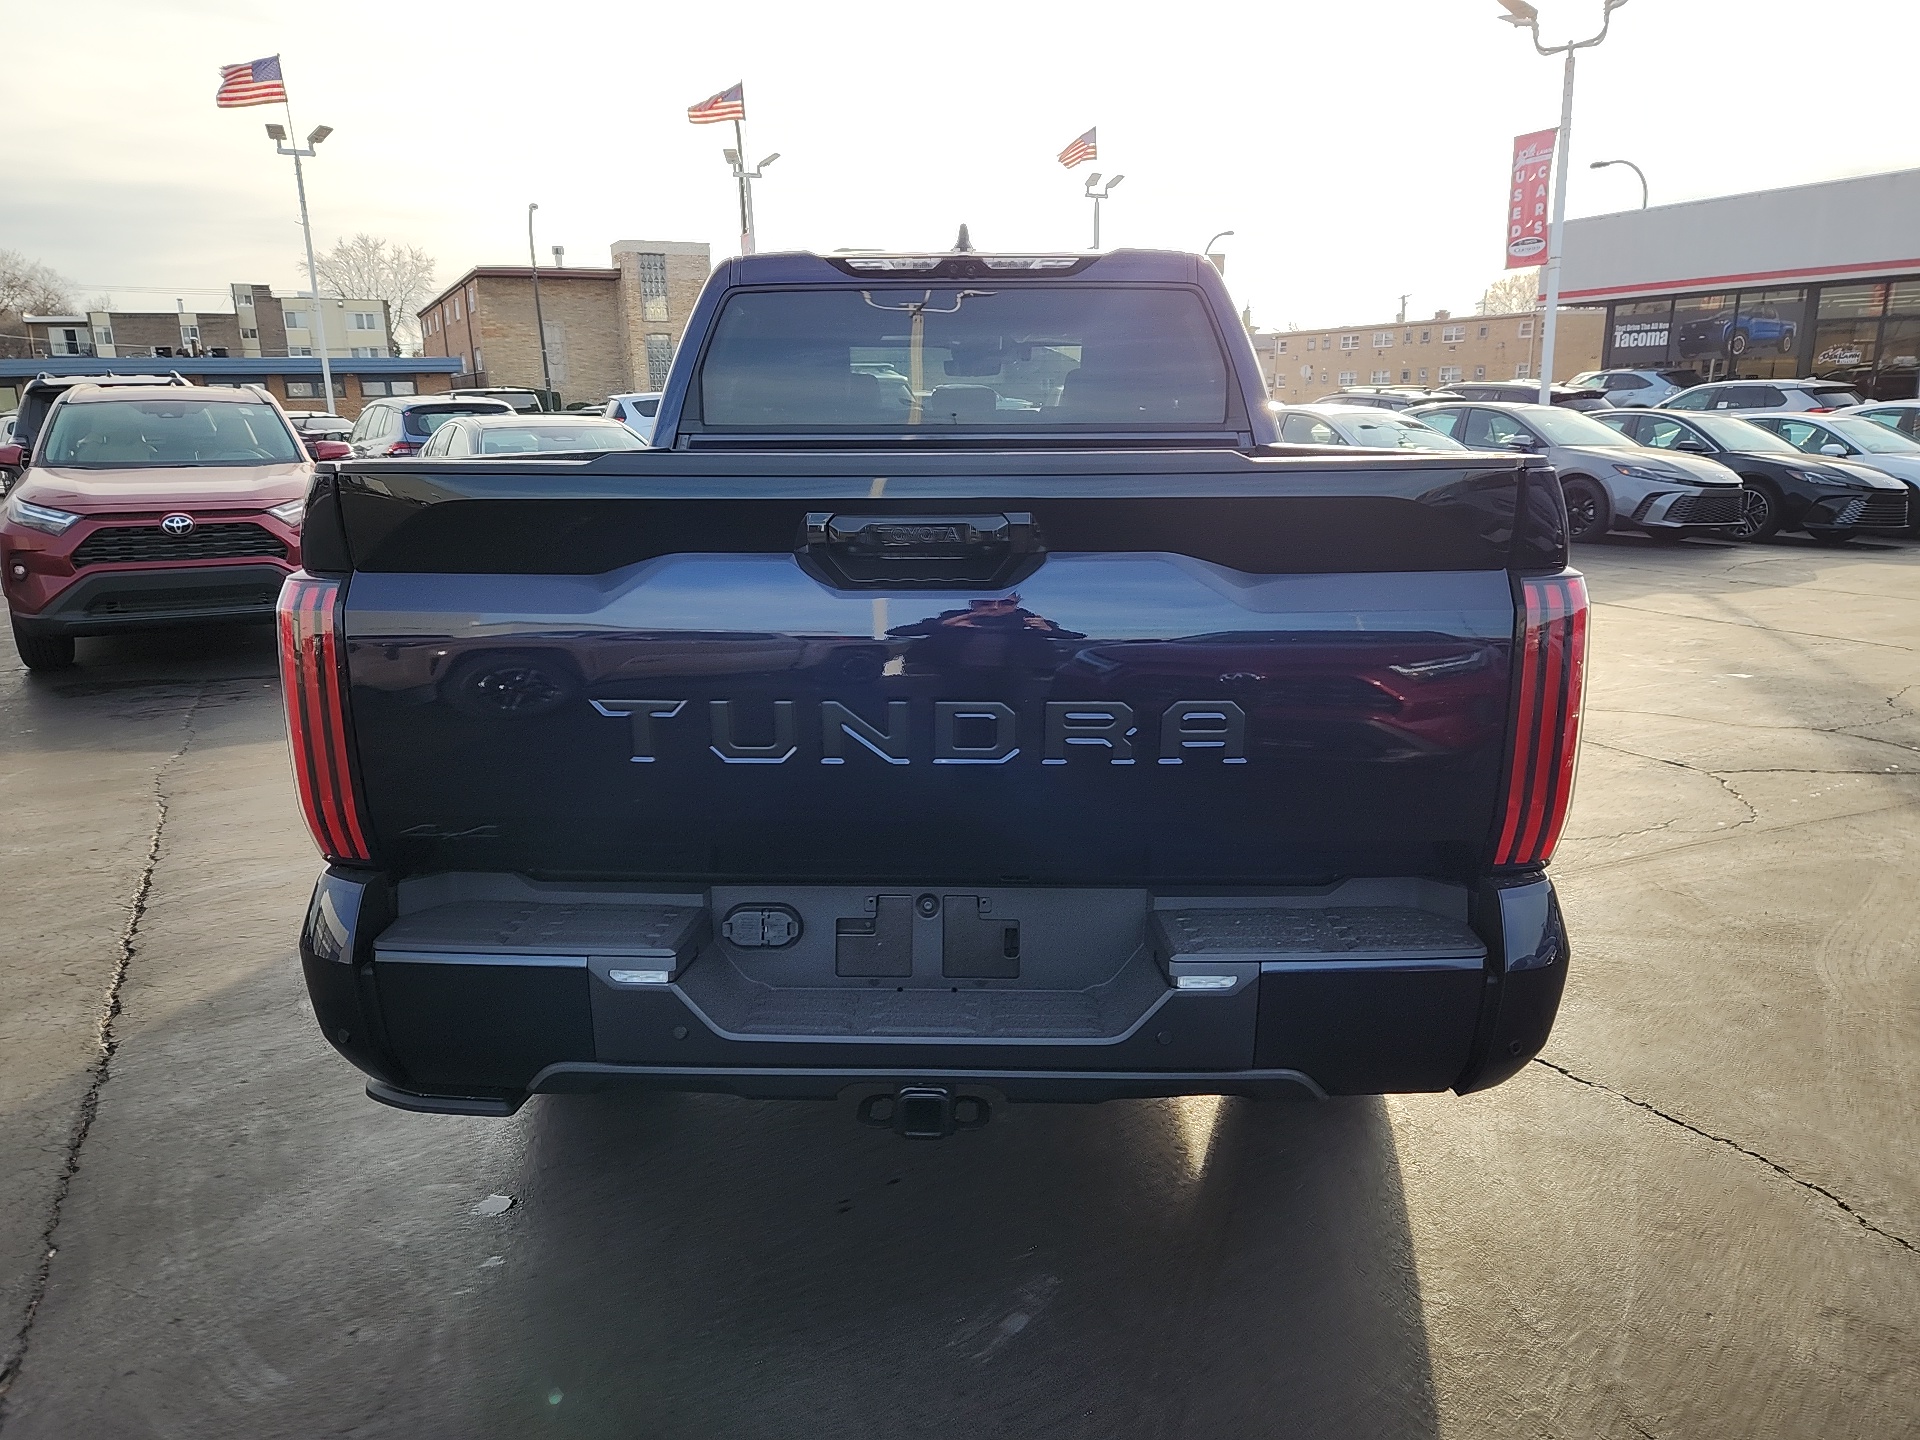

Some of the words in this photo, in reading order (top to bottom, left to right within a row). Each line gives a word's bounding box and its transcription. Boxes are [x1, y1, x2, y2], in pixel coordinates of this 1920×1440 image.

[1512, 171, 1525, 238] USED
[1534, 165, 1547, 235] CARS
[1614, 331, 1669, 347] Tacoma
[877, 526, 962, 543] TOYOTA
[588, 699, 1248, 766] TUNDRA
